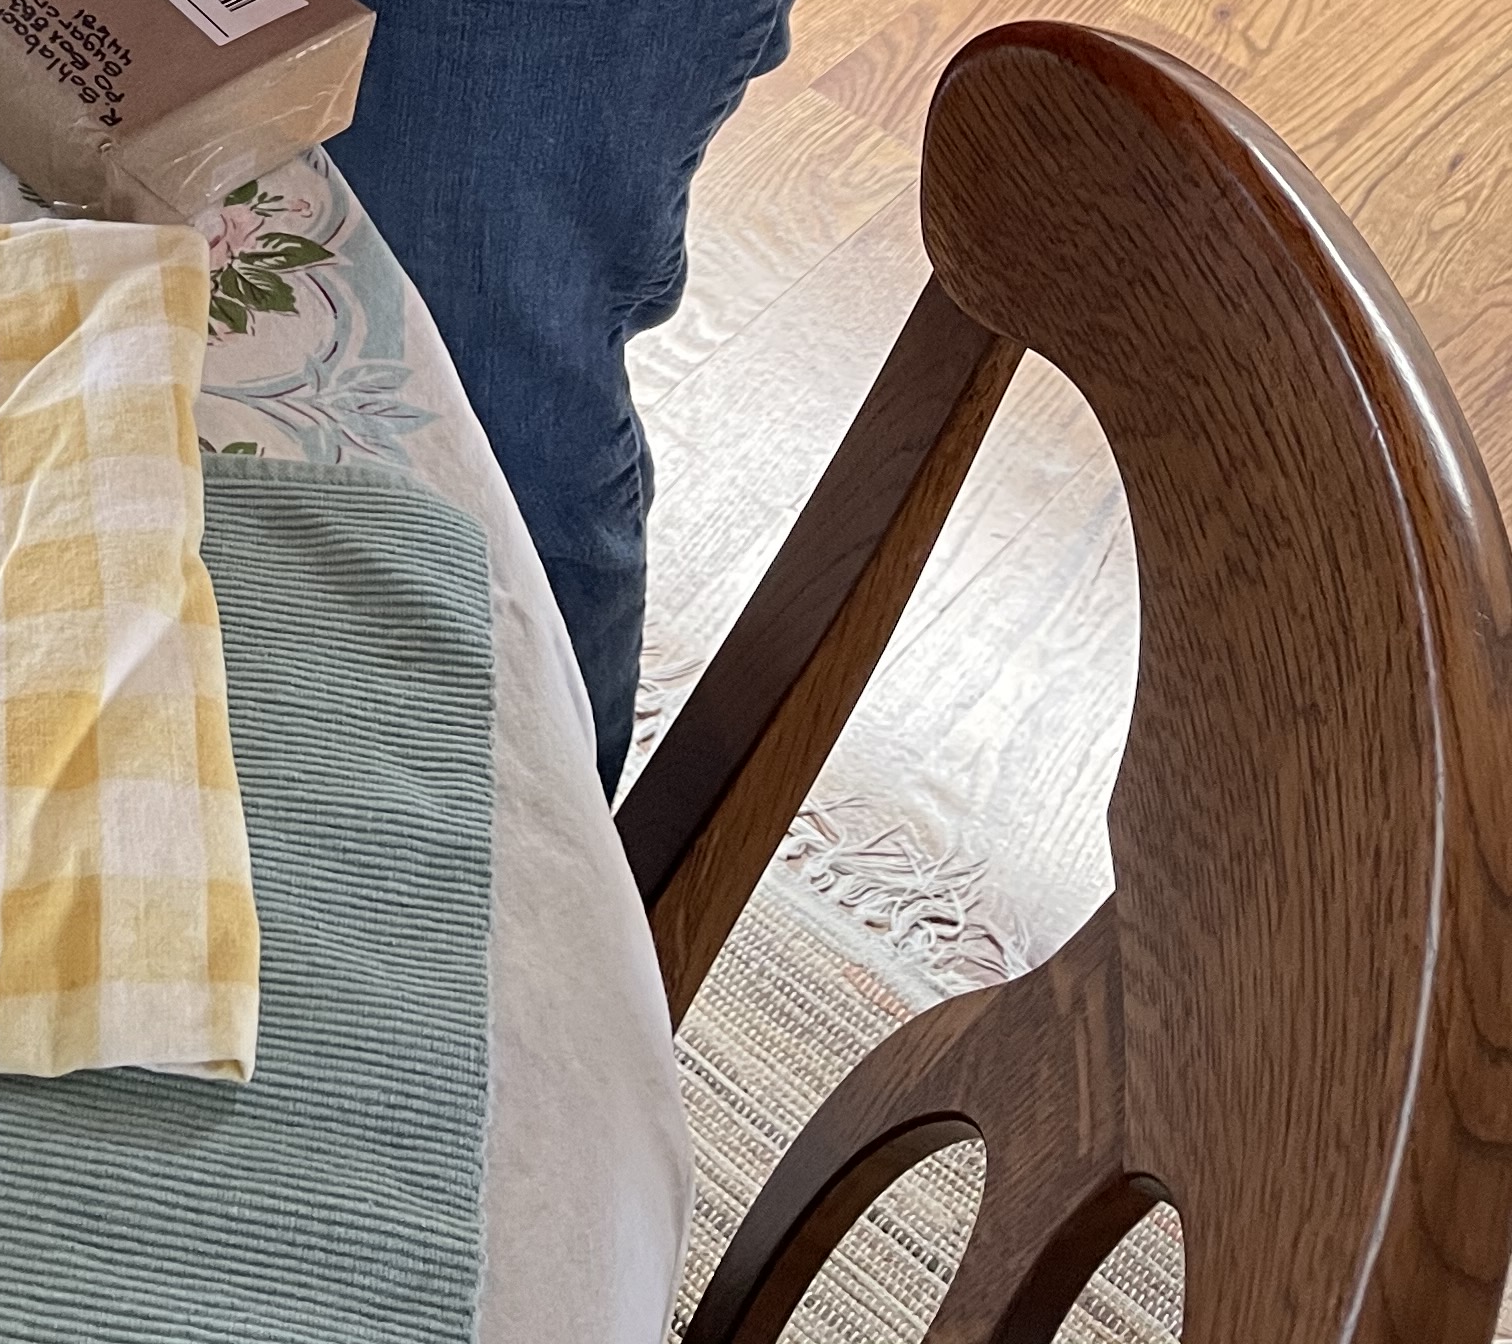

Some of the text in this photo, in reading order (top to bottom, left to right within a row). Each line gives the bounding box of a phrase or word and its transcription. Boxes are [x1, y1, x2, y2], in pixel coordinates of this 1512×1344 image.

[48, 29, 91, 71] Box
[94, 74, 125, 103] PO
[98, 101, 123, 127] R.
